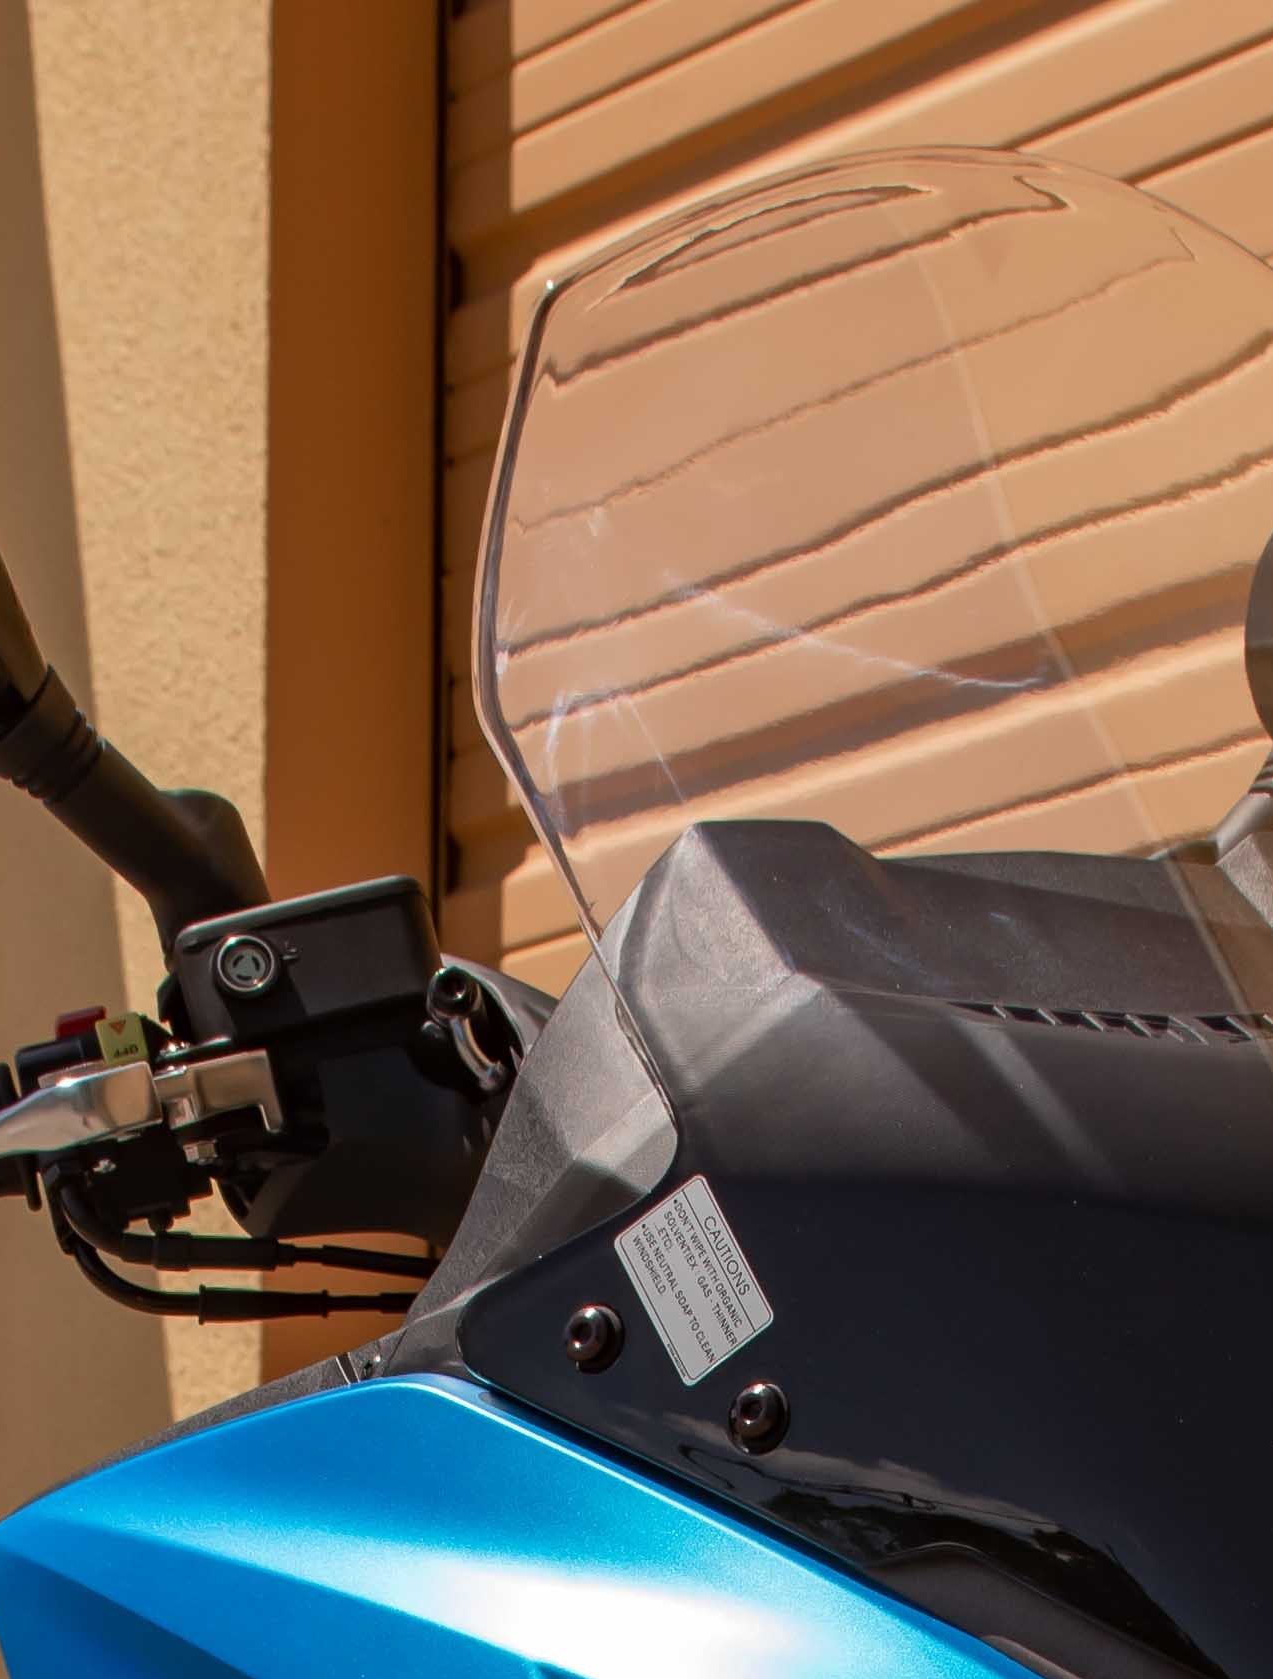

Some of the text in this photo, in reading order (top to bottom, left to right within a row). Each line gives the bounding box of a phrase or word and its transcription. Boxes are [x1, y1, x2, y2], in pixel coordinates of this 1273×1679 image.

[642, 1226, 714, 1363] USE NEUTRAL SOAP TO CLEAN
[674, 1203, 742, 1328] DON'T WIPE WITH ORGANIC
[703, 1215, 750, 1295] CAUTIONS
[697, 1275, 712, 1298] GAS
[711, 1301, 737, 1346] THINNER
